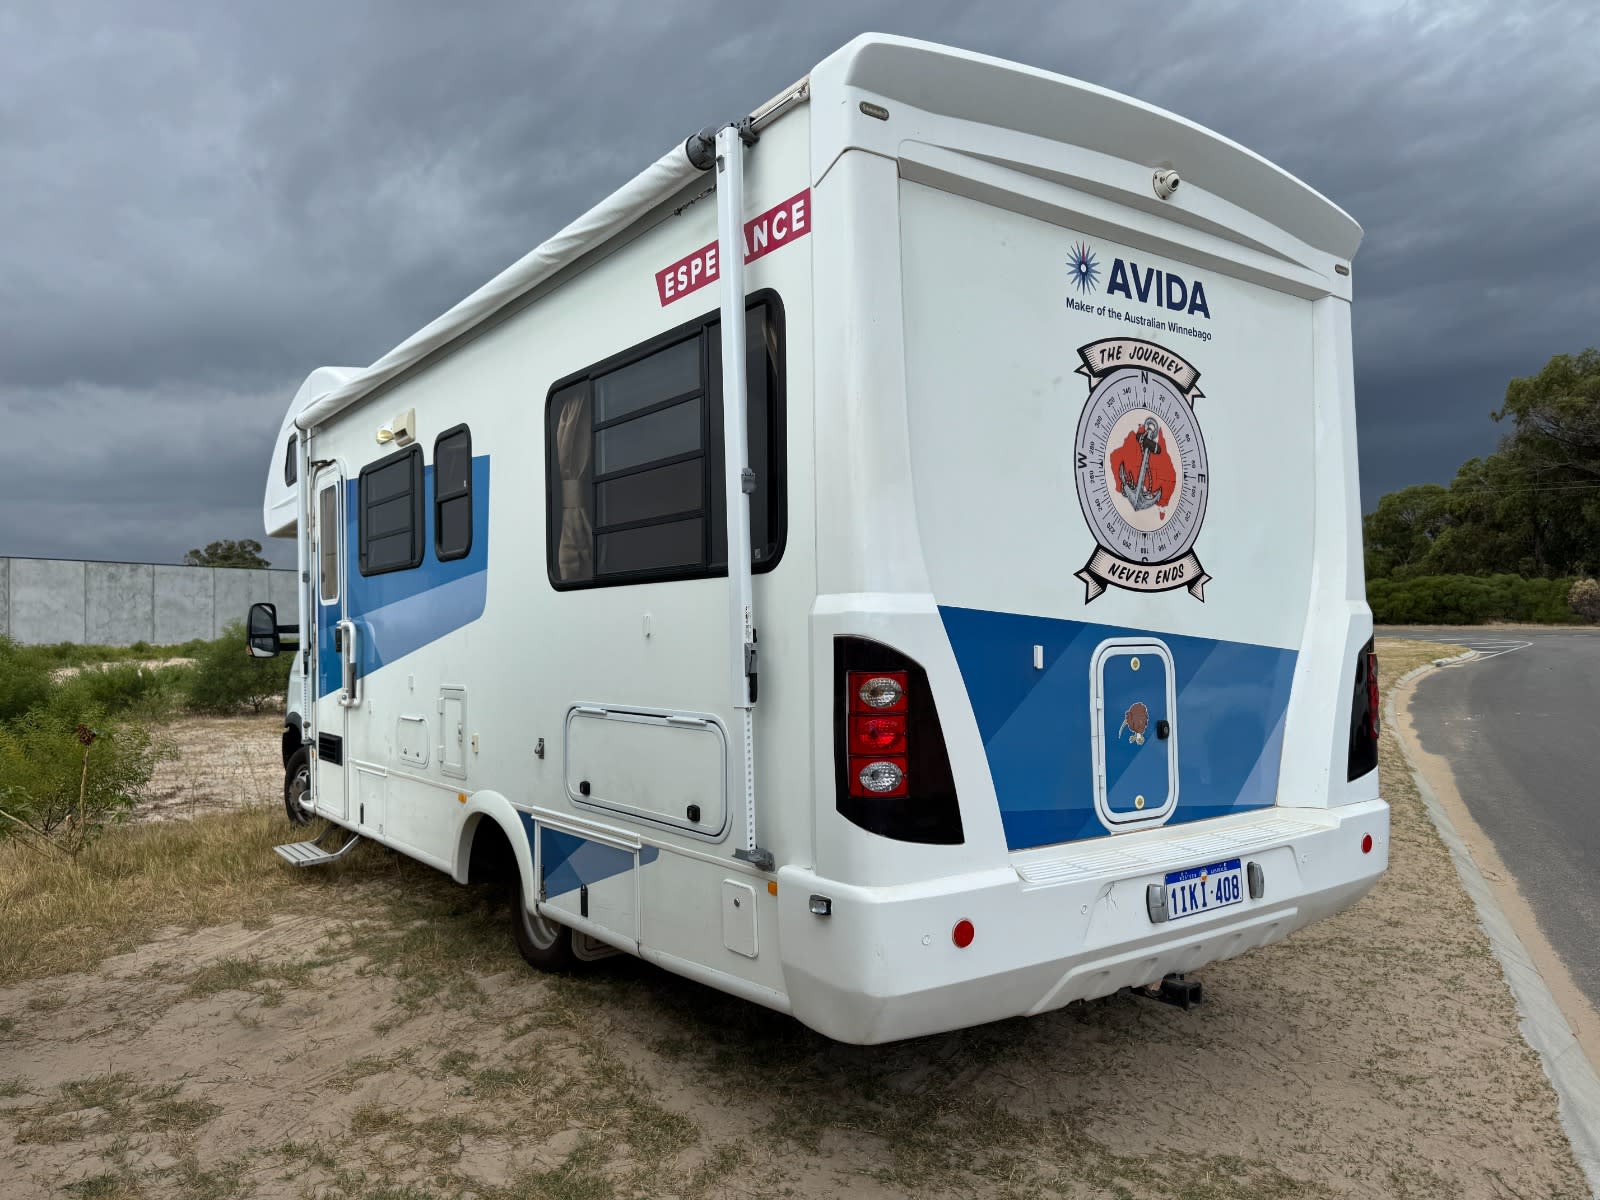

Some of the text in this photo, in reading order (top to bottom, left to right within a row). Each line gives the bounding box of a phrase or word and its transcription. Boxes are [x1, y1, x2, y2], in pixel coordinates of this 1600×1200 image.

[664, 199, 805, 299] ESPENCE
[1106, 257, 1211, 320] AVIDA
[1066, 297, 1212, 342] Maker of the Australian Winnebago
[1099, 345, 1184, 375] THE JOURNEY
[1141, 371, 1149, 385] N
[1078, 451, 1088, 469] W
[1197, 473, 1206, 484] E
[1107, 562, 1184, 585] NEVER ENDS
